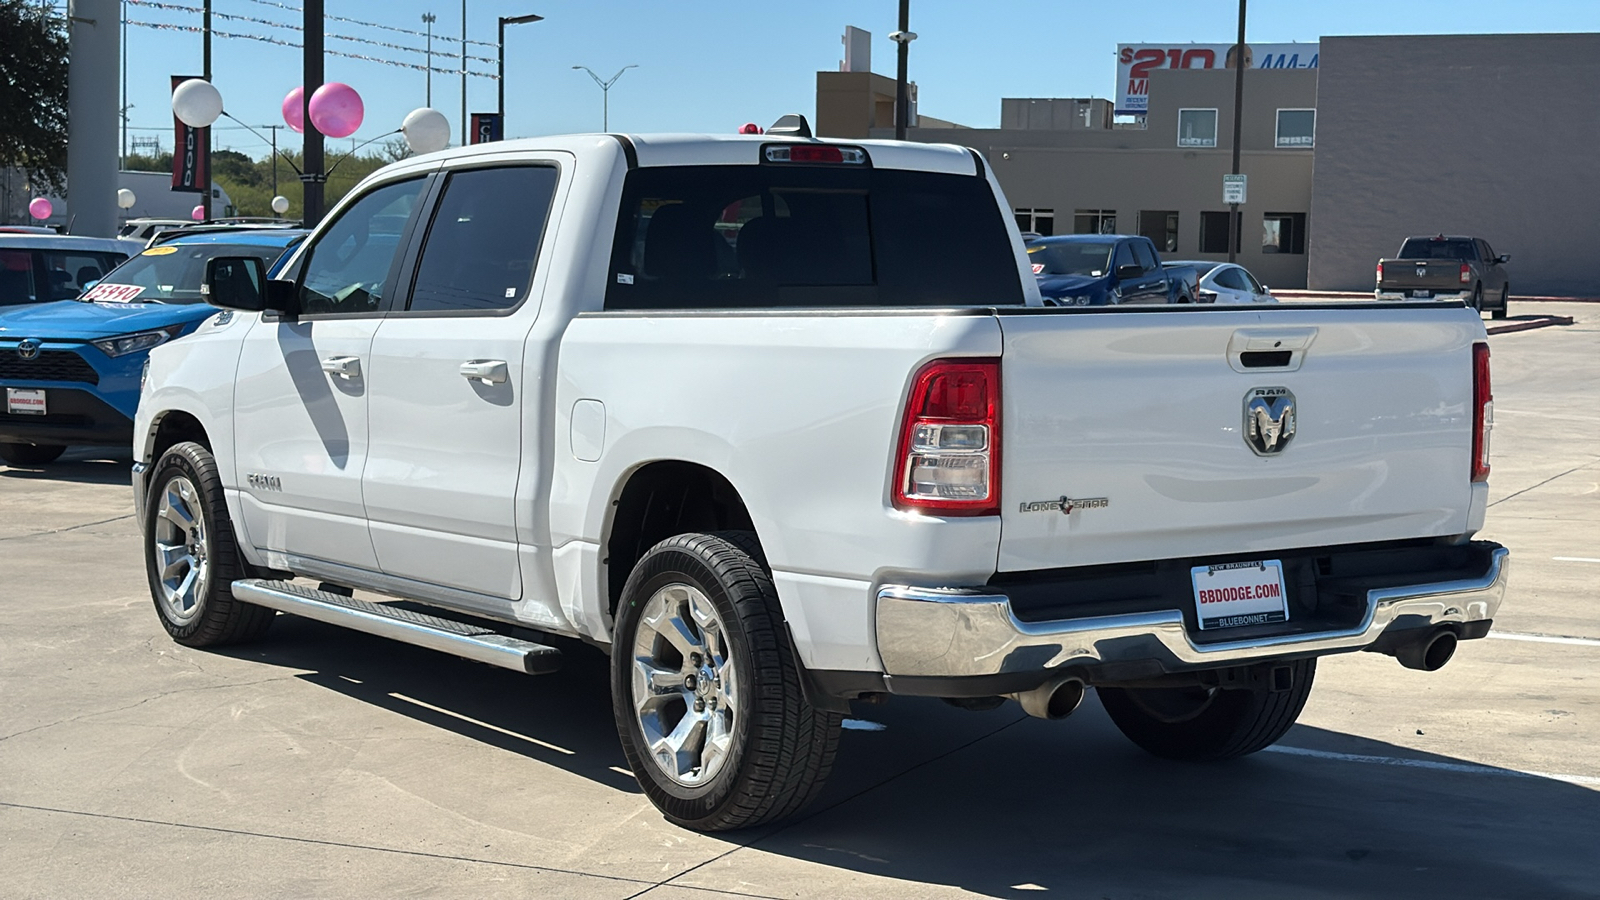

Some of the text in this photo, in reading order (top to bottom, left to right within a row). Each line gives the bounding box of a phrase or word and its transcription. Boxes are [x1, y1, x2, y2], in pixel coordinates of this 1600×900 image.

[1019, 499, 1109, 513] LONE STAR
[1199, 583, 1280, 604] BBDODGE.COM
[1219, 613, 1268, 627] BLUEBONNET
